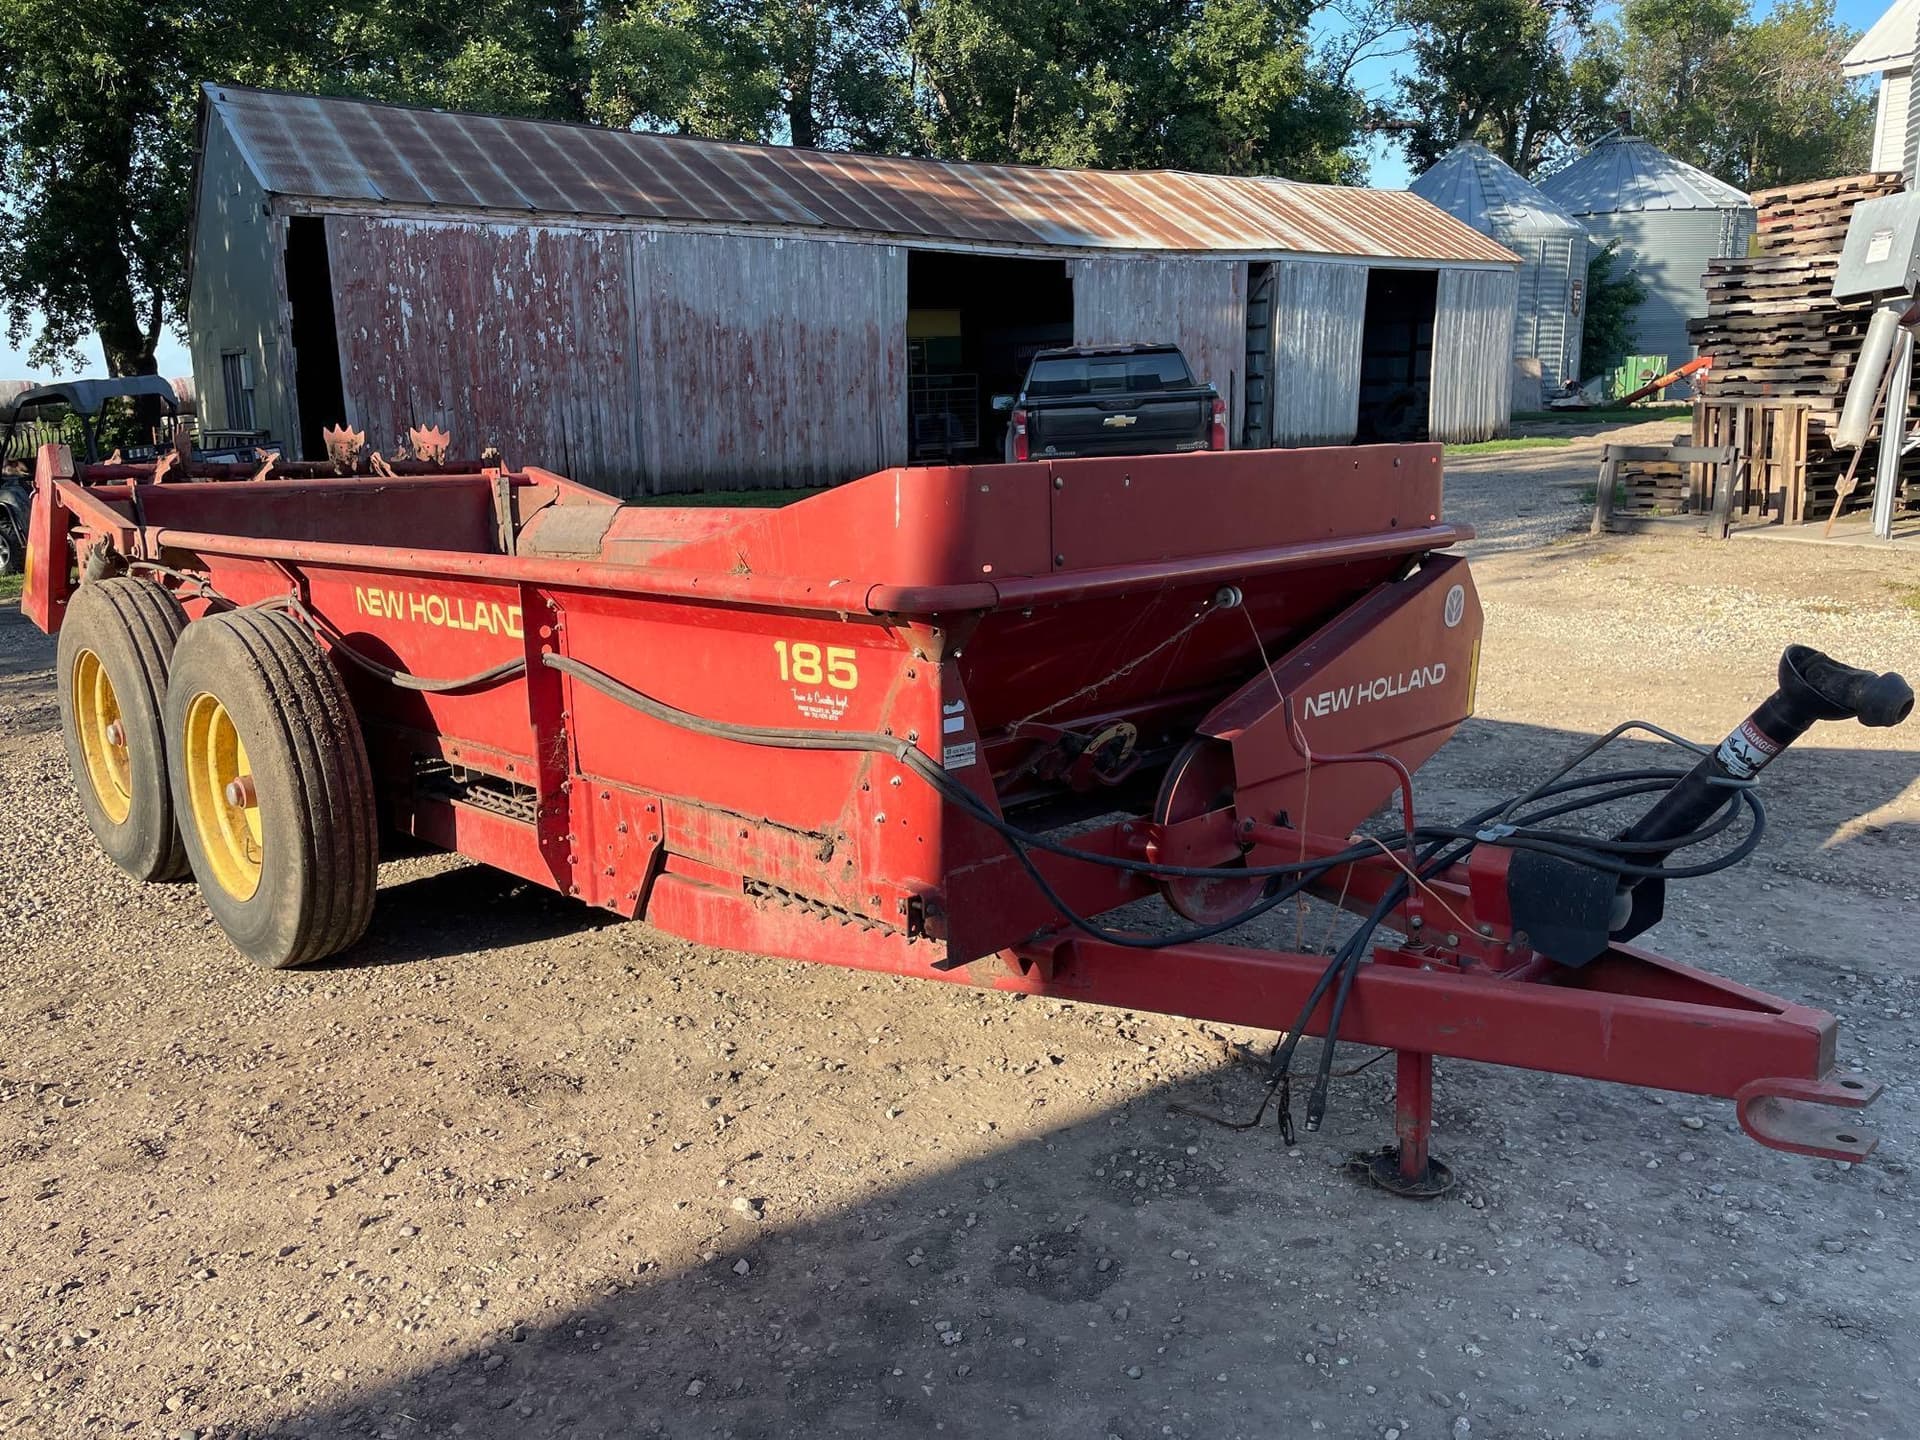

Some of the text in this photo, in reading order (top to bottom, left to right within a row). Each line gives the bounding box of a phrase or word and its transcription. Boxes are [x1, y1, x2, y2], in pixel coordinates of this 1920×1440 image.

[355, 586, 525, 640] NEW HOLLAND
[773, 640, 859, 690] 185
[1304, 662, 1447, 721] NEW HOLLAND
[1743, 726, 1779, 754] DANGER
